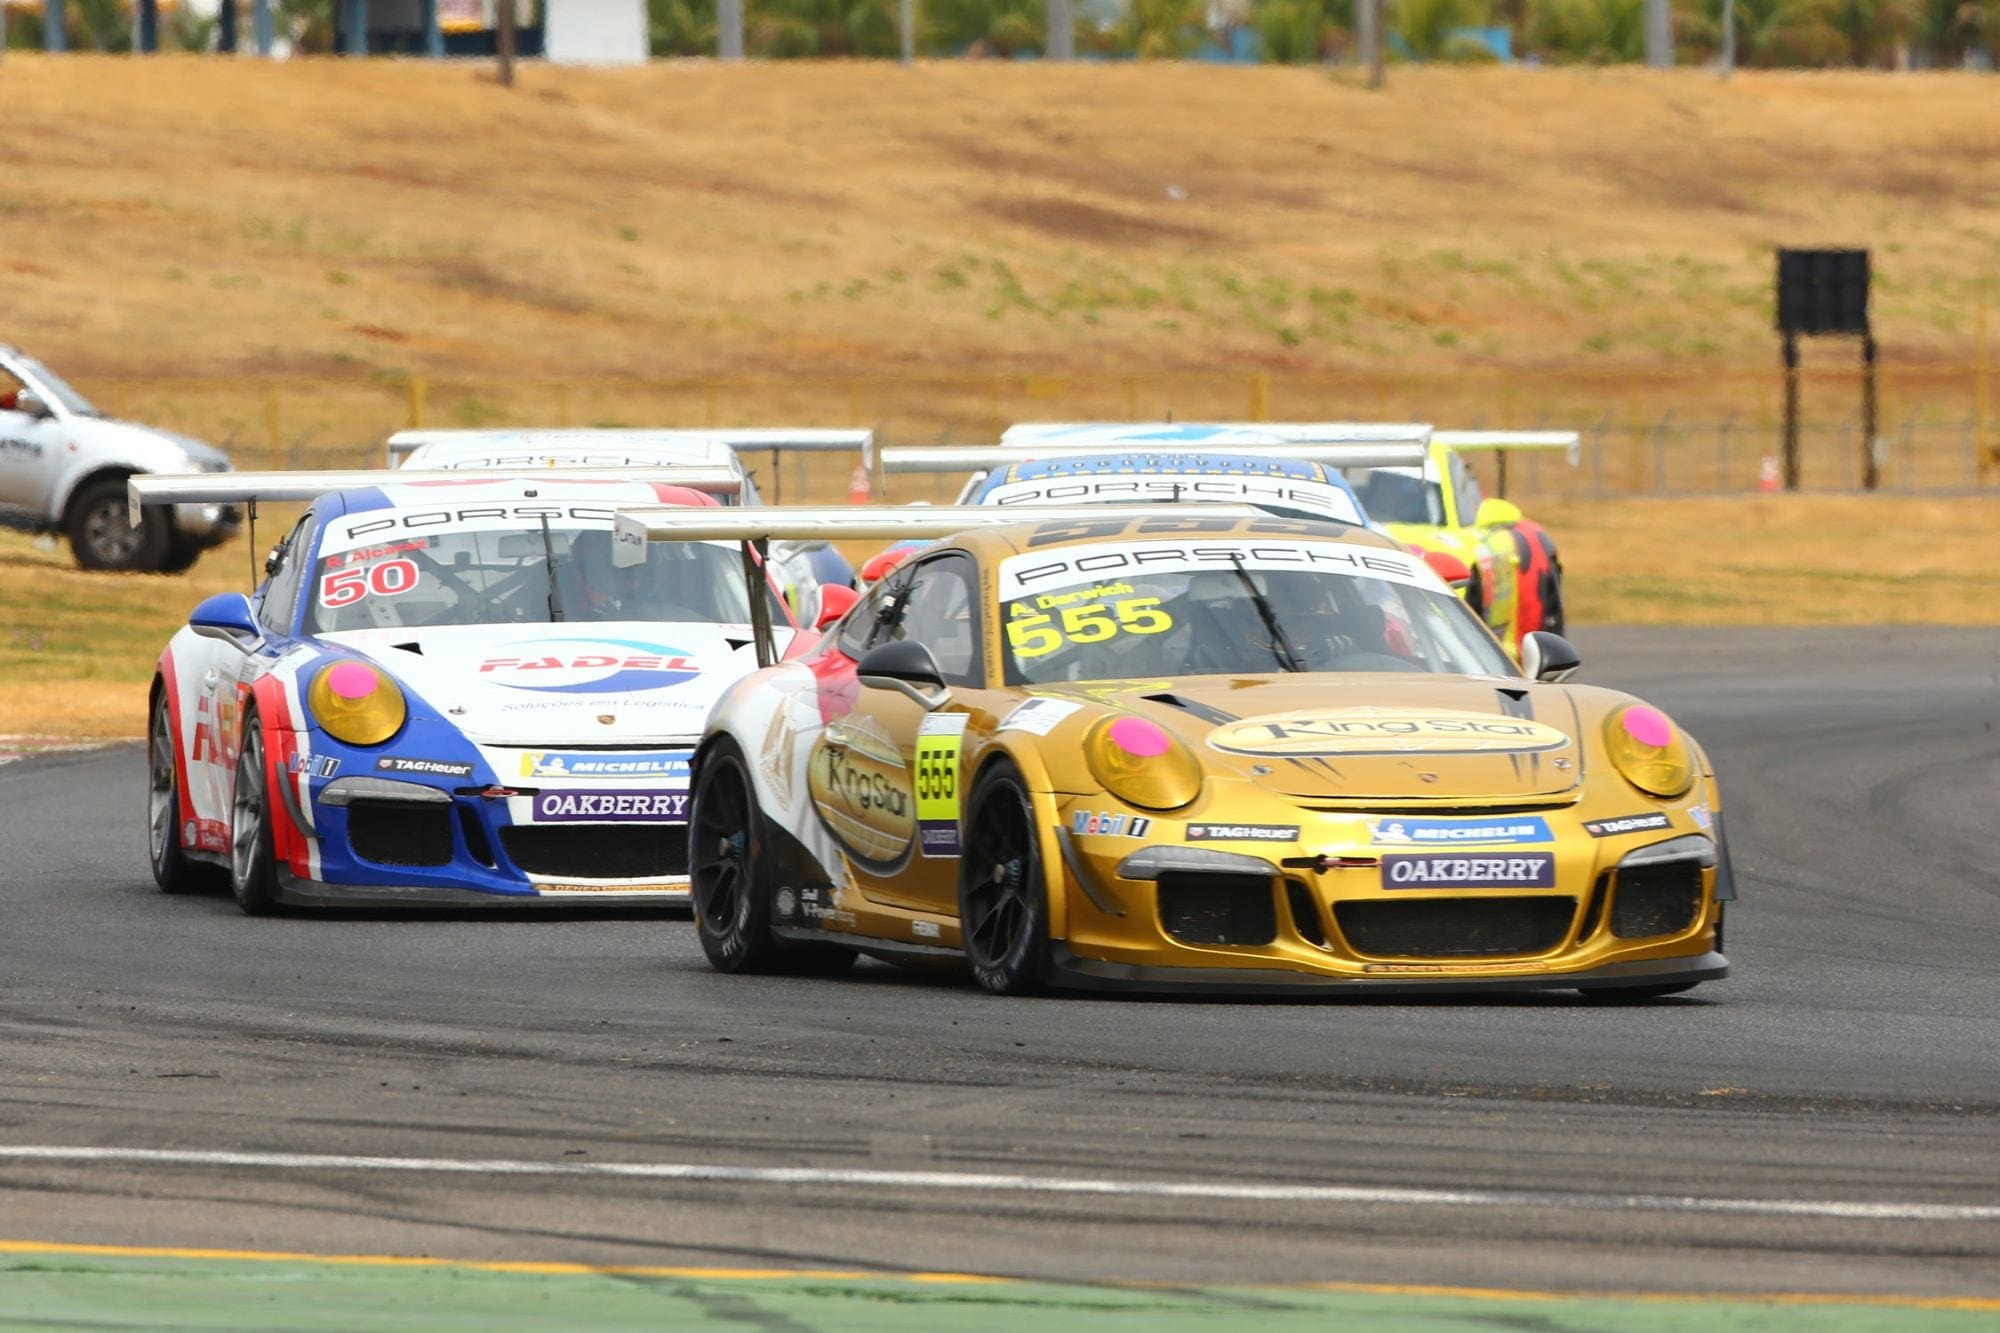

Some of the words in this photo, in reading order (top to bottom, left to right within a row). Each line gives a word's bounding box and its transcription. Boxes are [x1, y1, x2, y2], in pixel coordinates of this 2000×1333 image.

[346, 506, 615, 540] PORSC
[1015, 547, 1415, 586] PORSCHE
[319, 558, 420, 609] 50
[1005, 597, 1173, 658] 555
[478, 656, 700, 672] FADEL
[289, 751, 323, 776] Mobil
[571, 761, 690, 772] MICHELIN
[919, 749, 955, 800] 555
[542, 795, 689, 815] OAKBERRY
[1072, 811, 1124, 835] Mobil
[1413, 824, 1536, 839] MICHELIN
[1391, 858, 1547, 882] OAKBERRY
